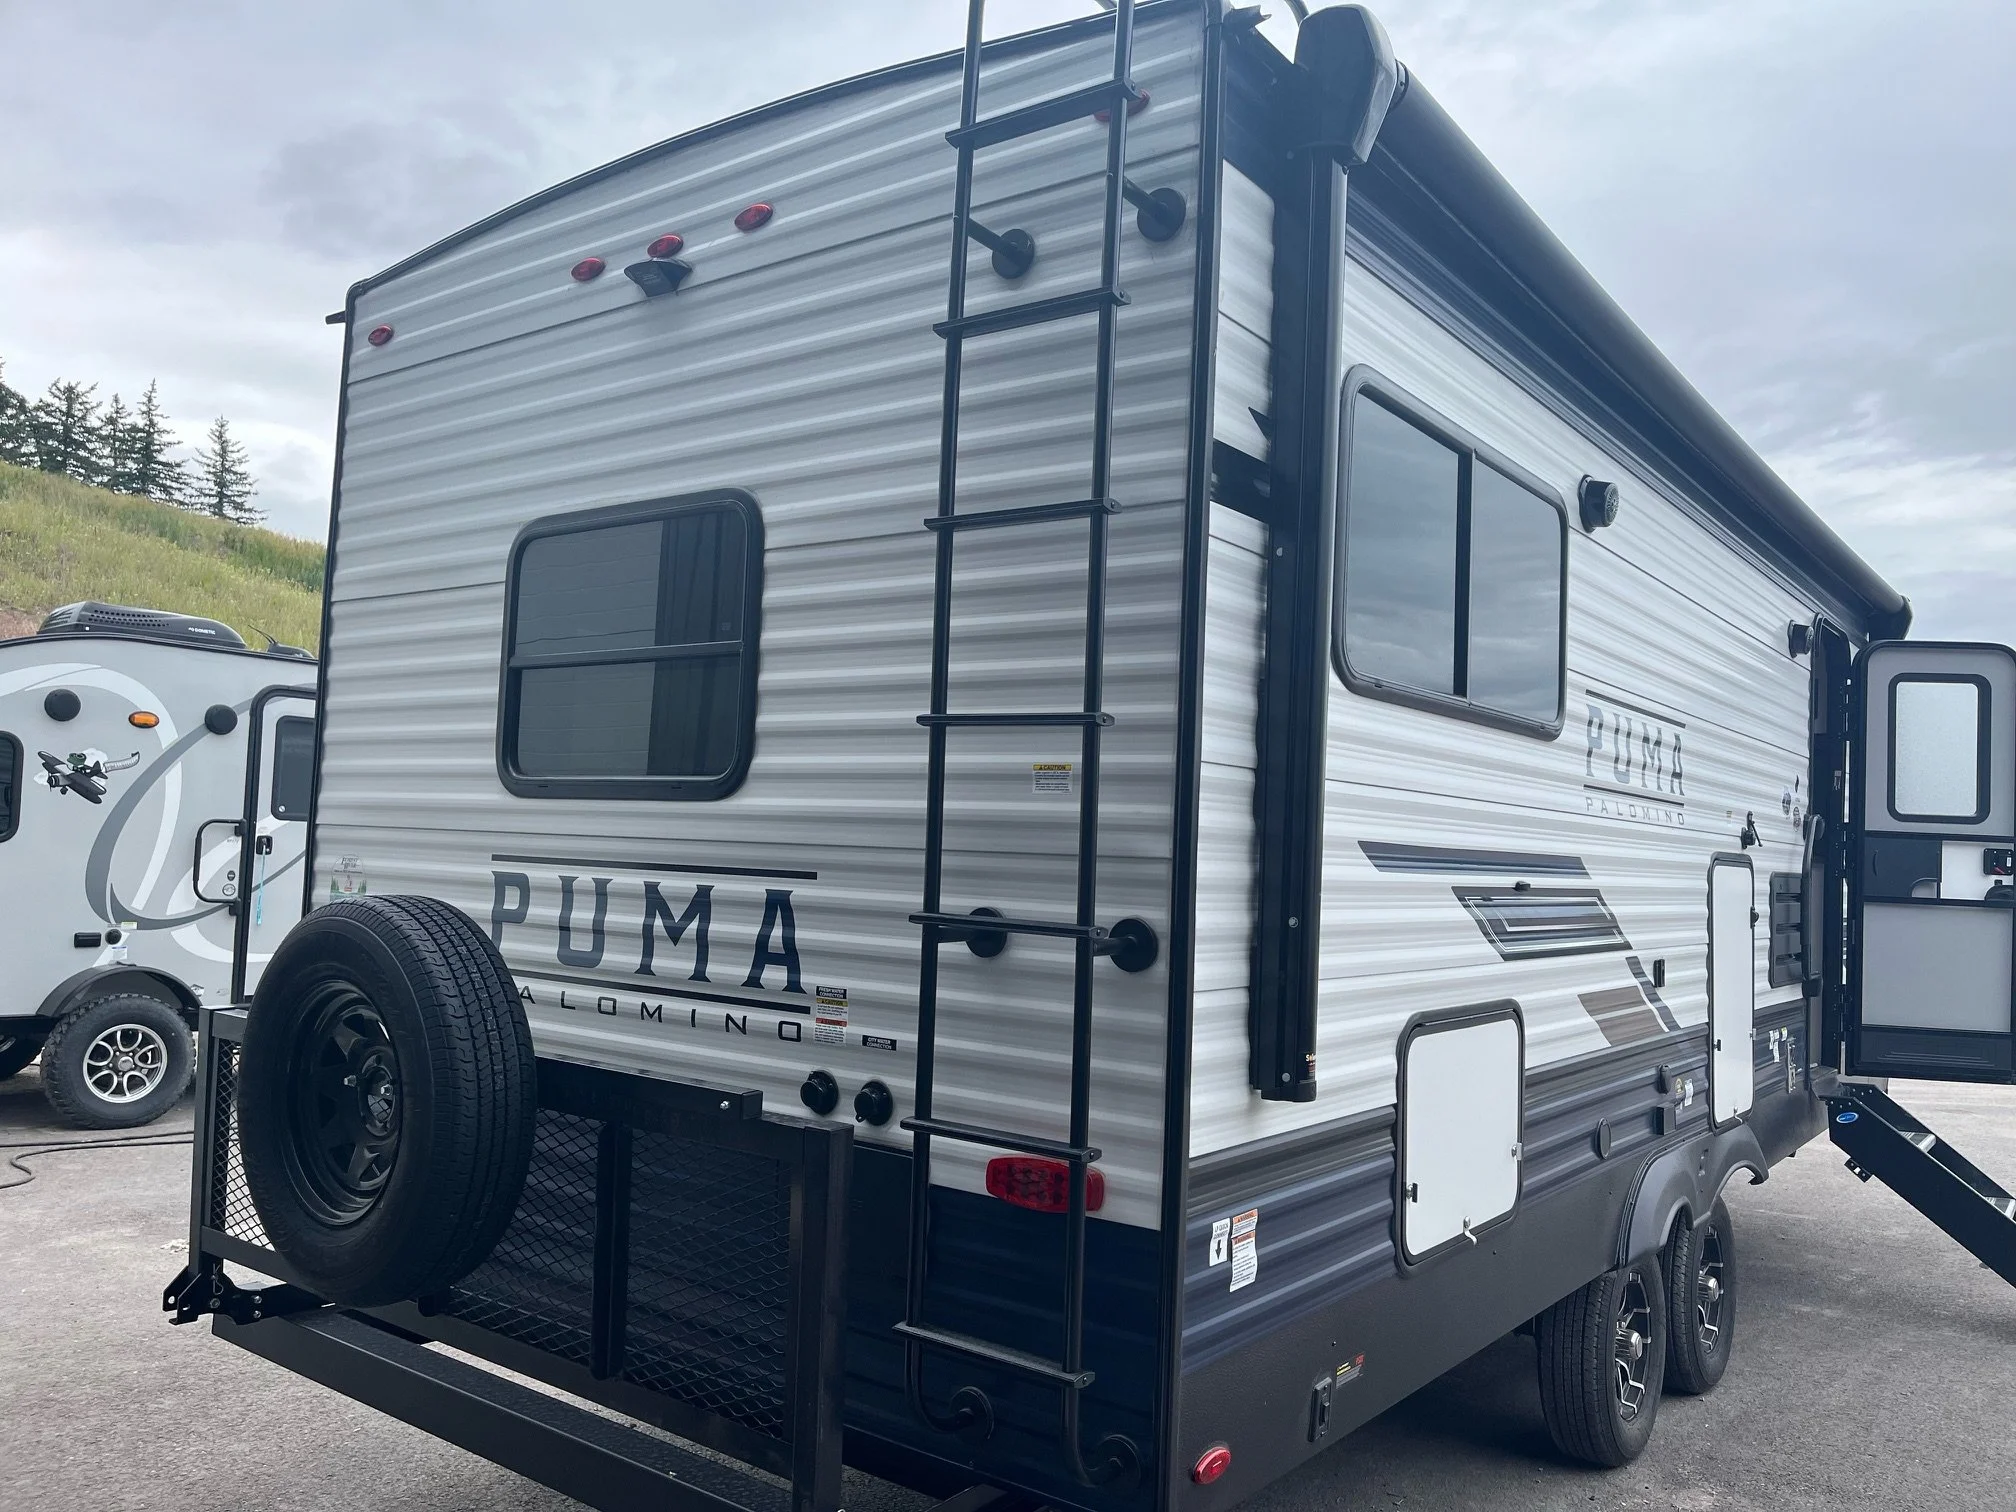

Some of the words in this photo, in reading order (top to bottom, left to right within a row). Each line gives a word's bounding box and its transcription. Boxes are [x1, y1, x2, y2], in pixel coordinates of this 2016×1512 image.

[194, 627, 216, 635] DOMETIC
[1585, 703, 1685, 796] PUMA
[1585, 797, 1685, 825] PALOMINO
[491, 870, 807, 994] PUMA
[819, 991, 844, 999] CONNECTION
[519, 985, 802, 1042] ALOMINO
[866, 1042, 892, 1050] CONNECTION
